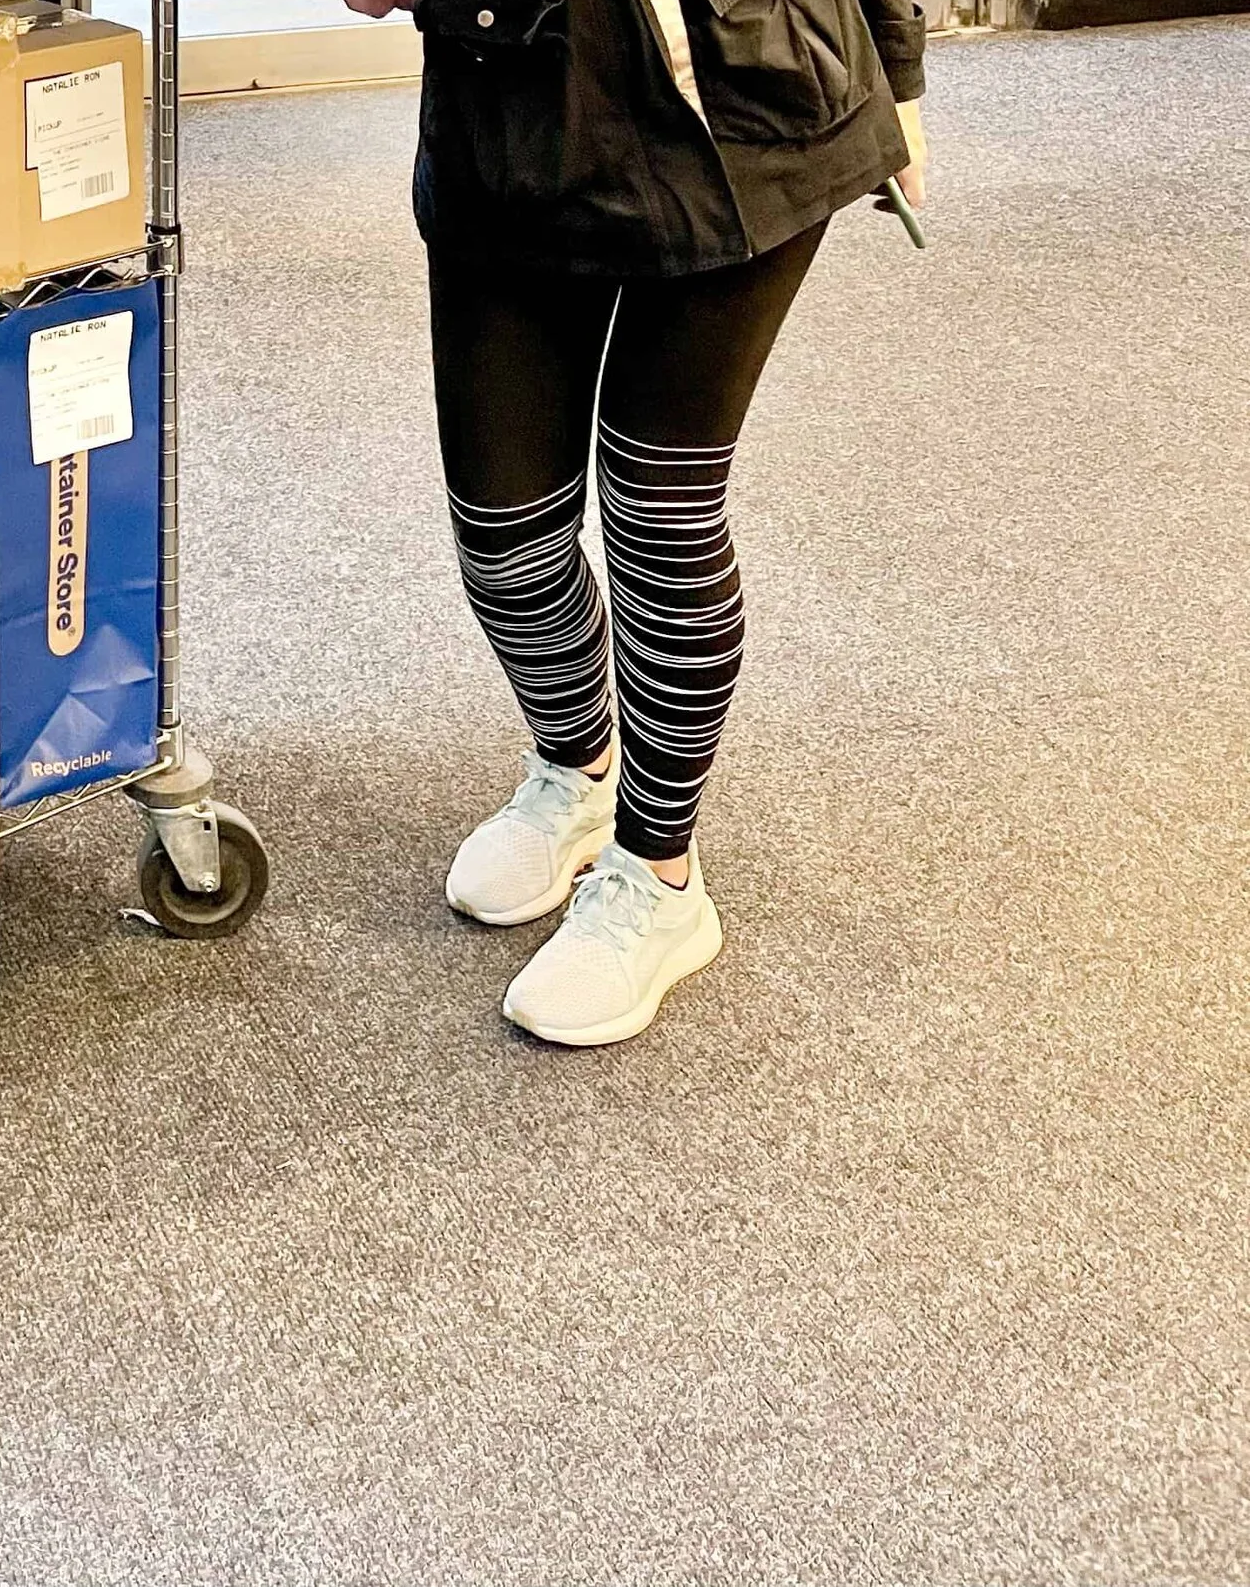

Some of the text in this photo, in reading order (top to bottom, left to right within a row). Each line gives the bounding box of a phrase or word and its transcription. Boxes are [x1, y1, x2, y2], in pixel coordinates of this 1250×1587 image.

[42, 71, 101, 94] NATALIE RON
[40, 321, 107, 343] NATALIE RON
[31, 748, 112, 778] Recyclable
